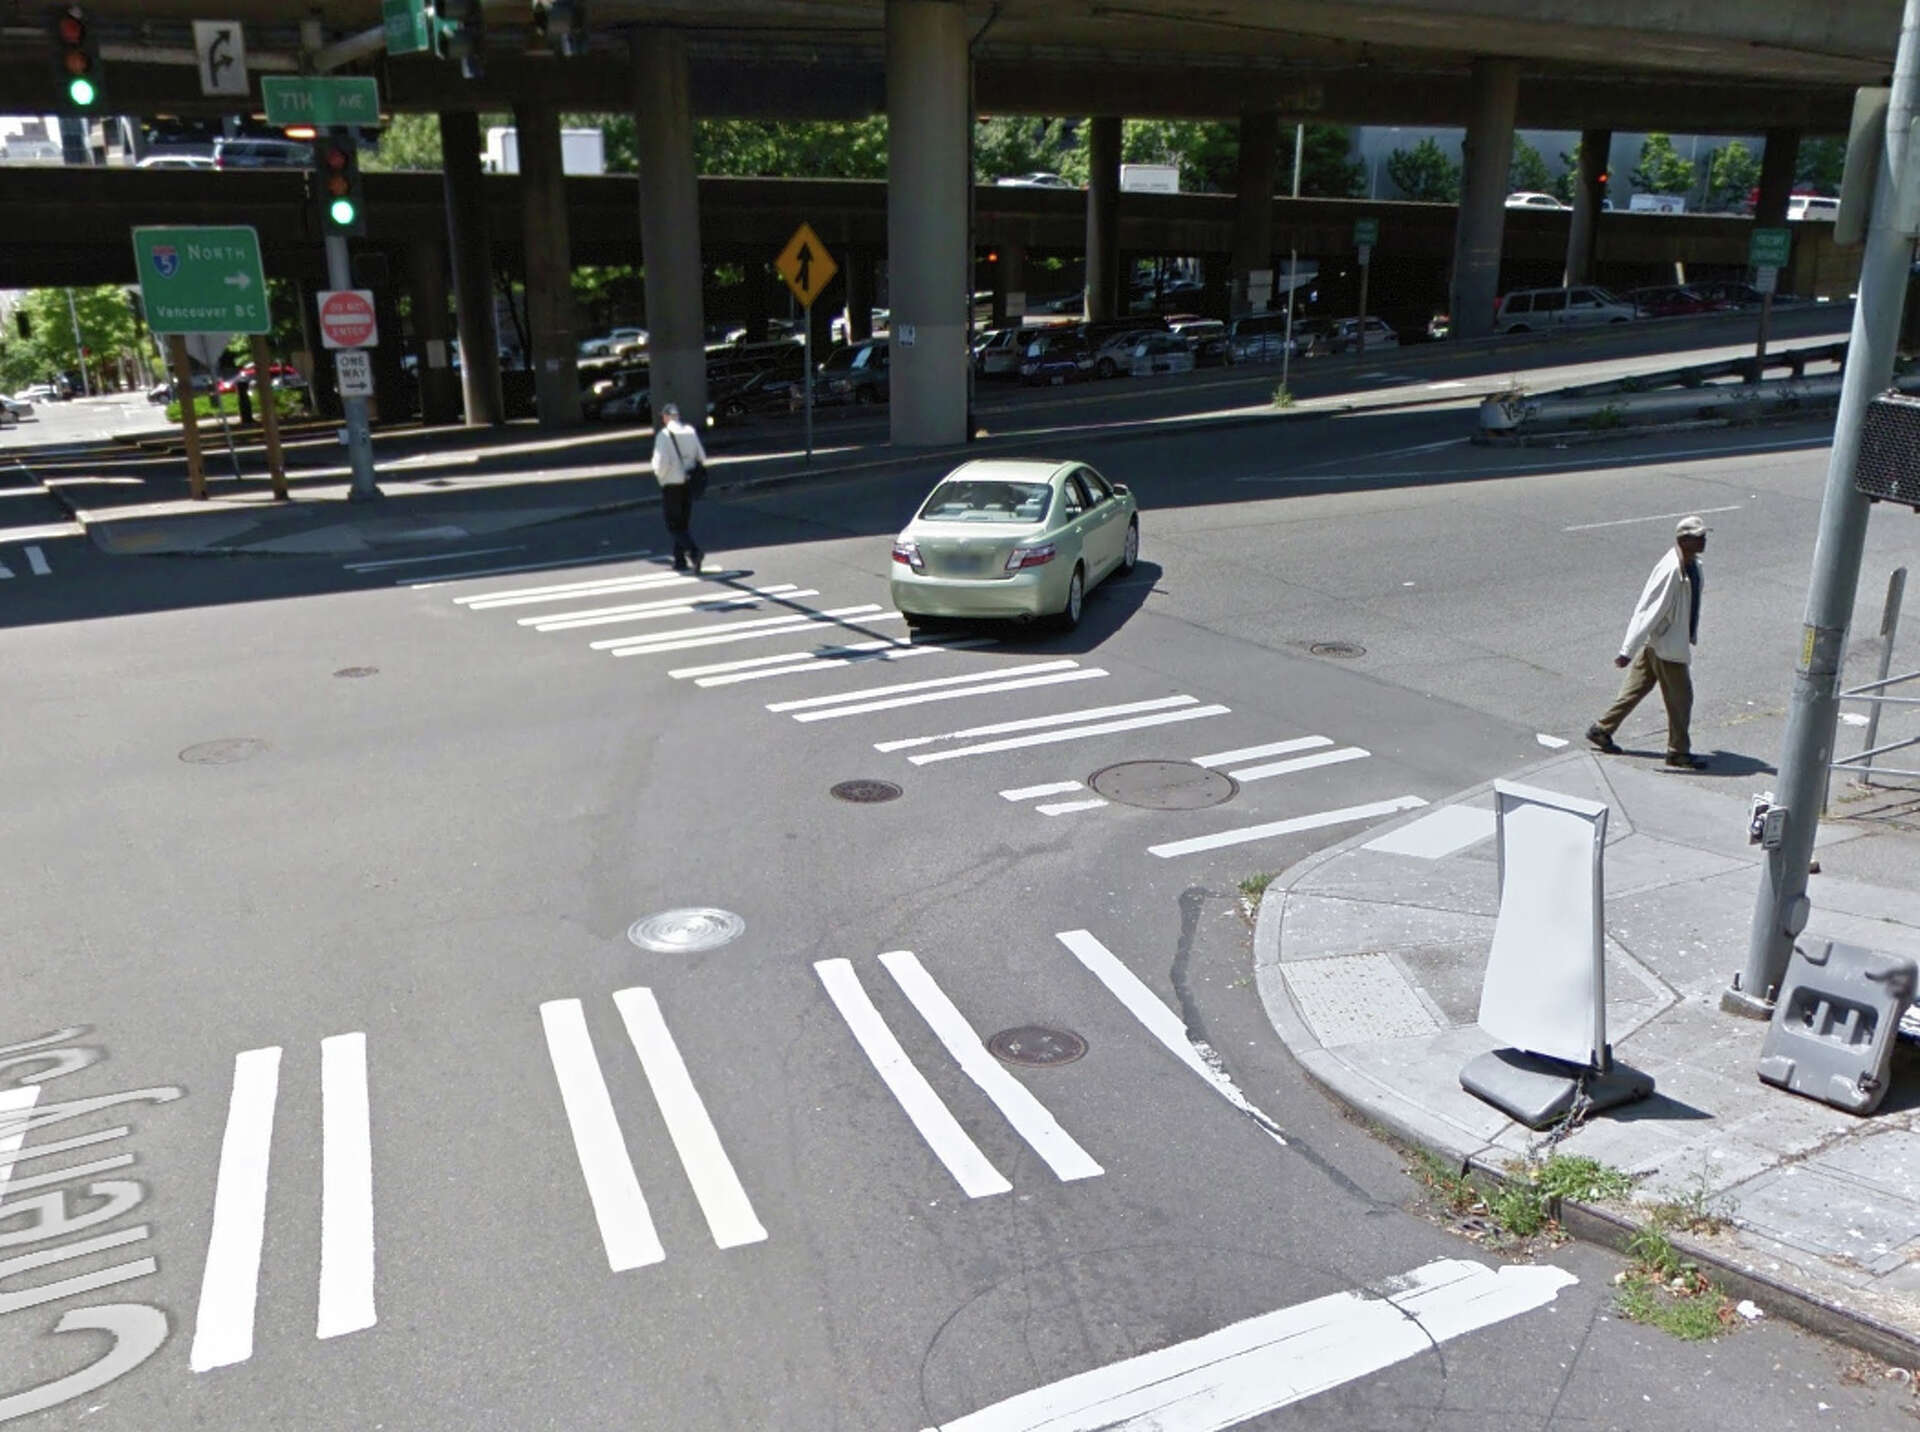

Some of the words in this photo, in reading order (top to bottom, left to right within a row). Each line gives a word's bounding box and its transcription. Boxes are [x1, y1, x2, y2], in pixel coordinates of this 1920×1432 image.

[161, 255, 173, 275] 5
[341, 356, 365, 367] ONE
[342, 368, 367, 378] WAY
